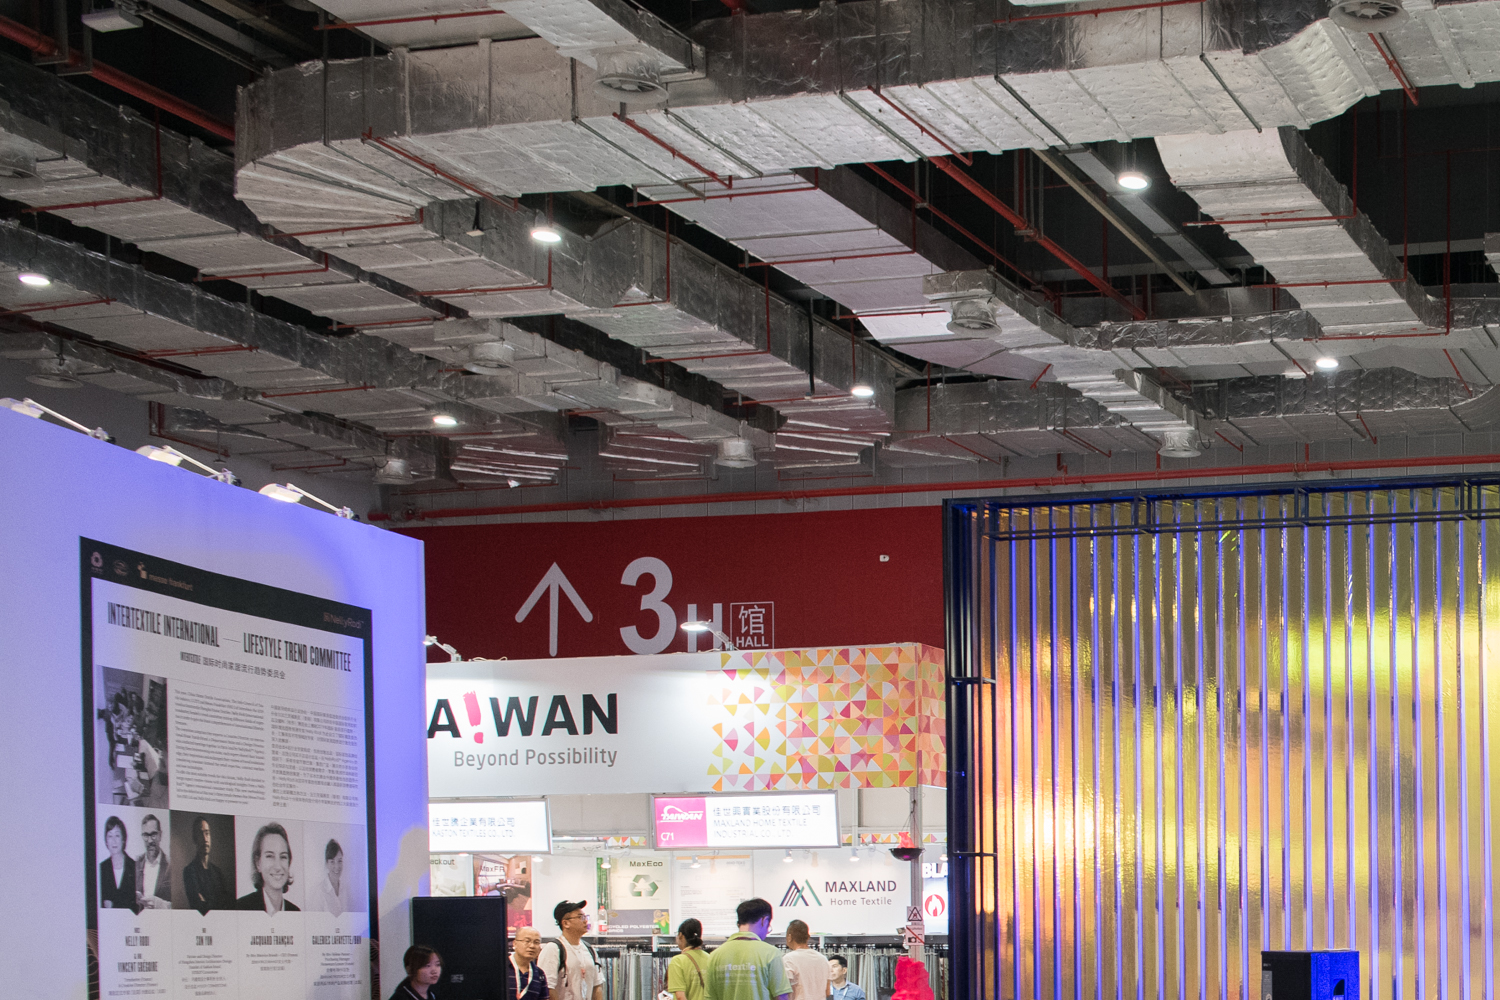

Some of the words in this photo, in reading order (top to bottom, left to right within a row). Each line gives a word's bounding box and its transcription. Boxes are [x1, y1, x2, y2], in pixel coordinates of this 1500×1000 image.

[107, 601, 162, 635] INTERTEXTILE
[163, 614, 219, 648] INTERNATIONAL
[738, 604, 766, 635] 馆
[736, 636, 769, 648] HALL
[243, 632, 282, 659] LIFESTYLE
[284, 640, 308, 664] TREND
[309, 646, 351, 672] COMMITTEE
[454, 749, 519, 770] Beyond
[525, 747, 617, 768] Possibility
[713, 819, 751, 827] MAXLAND
[753, 819, 776, 827] HOME
[778, 818, 807, 826] TEXTILE
[660, 832, 675, 841] C71
[713, 829, 759, 838] INDUSTRIAL
[825, 880, 897, 893] MAXLAND
[830, 898, 857, 906] Home
[861, 896, 892, 906] Textile
